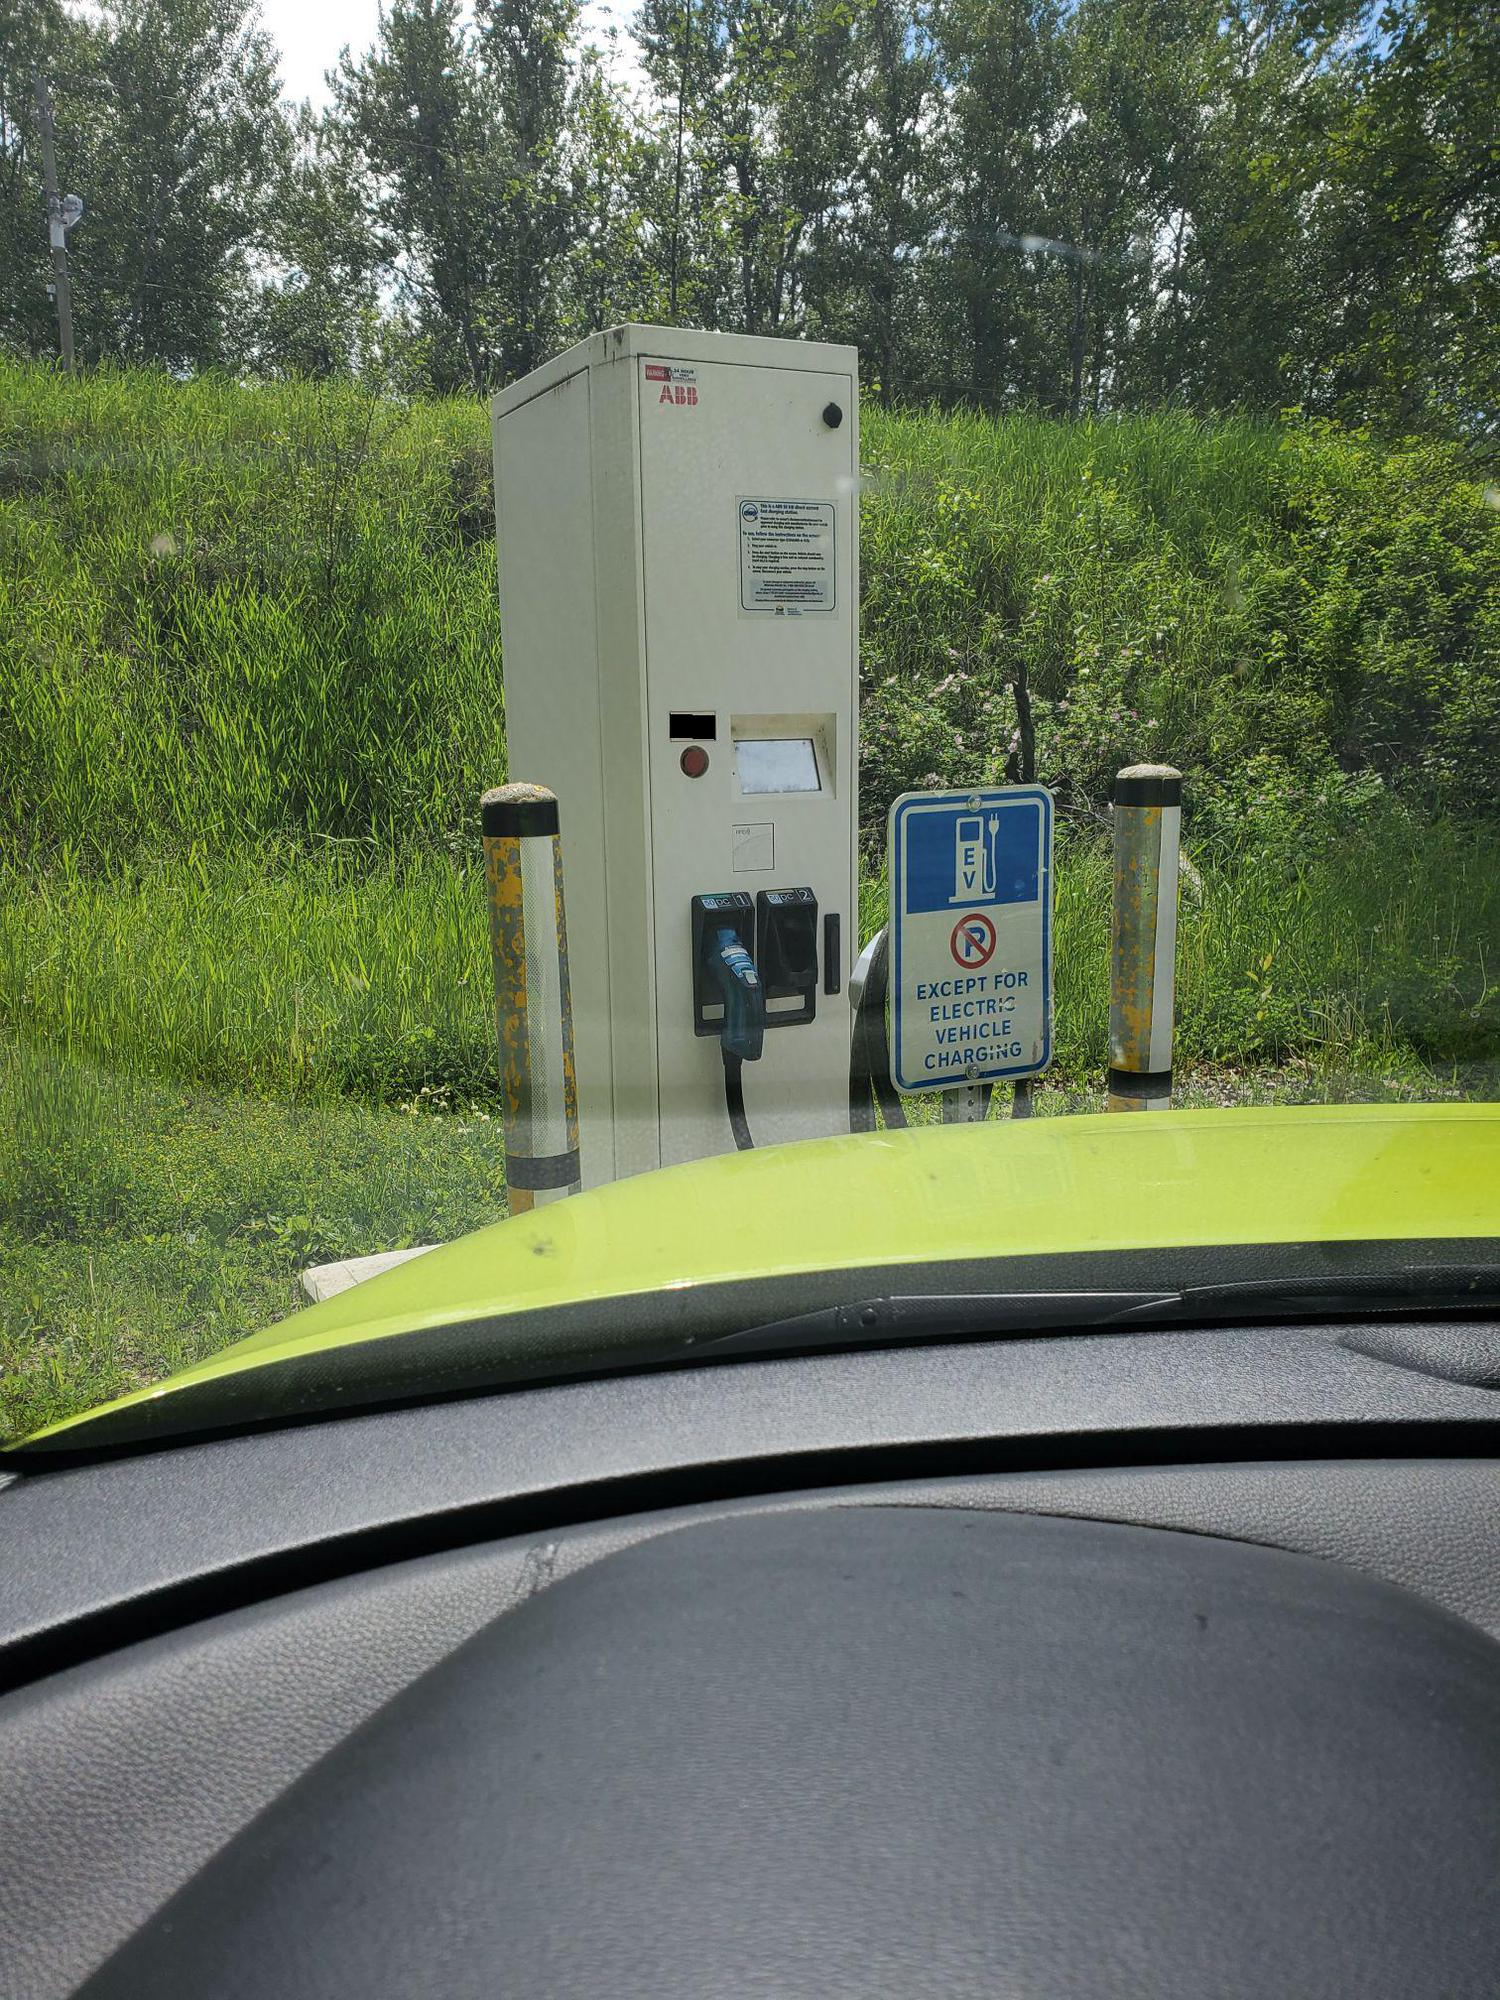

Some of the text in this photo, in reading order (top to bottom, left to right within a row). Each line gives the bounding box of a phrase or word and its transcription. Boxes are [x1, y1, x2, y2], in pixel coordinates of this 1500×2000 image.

[659, 385, 698, 406] ABB
[963, 847, 976, 889] EV
[716, 898, 731, 906] DC
[736, 894, 745, 905] 1
[781, 893, 794, 901] DC
[799, 890, 811, 902] 2
[917, 971, 1028, 1000] EXCEPT FOR
[930, 996, 1016, 1022] ELECTRIC
[935, 1020, 1012, 1044] VEHICLE
[924, 1041, 1022, 1070] CHARGING
